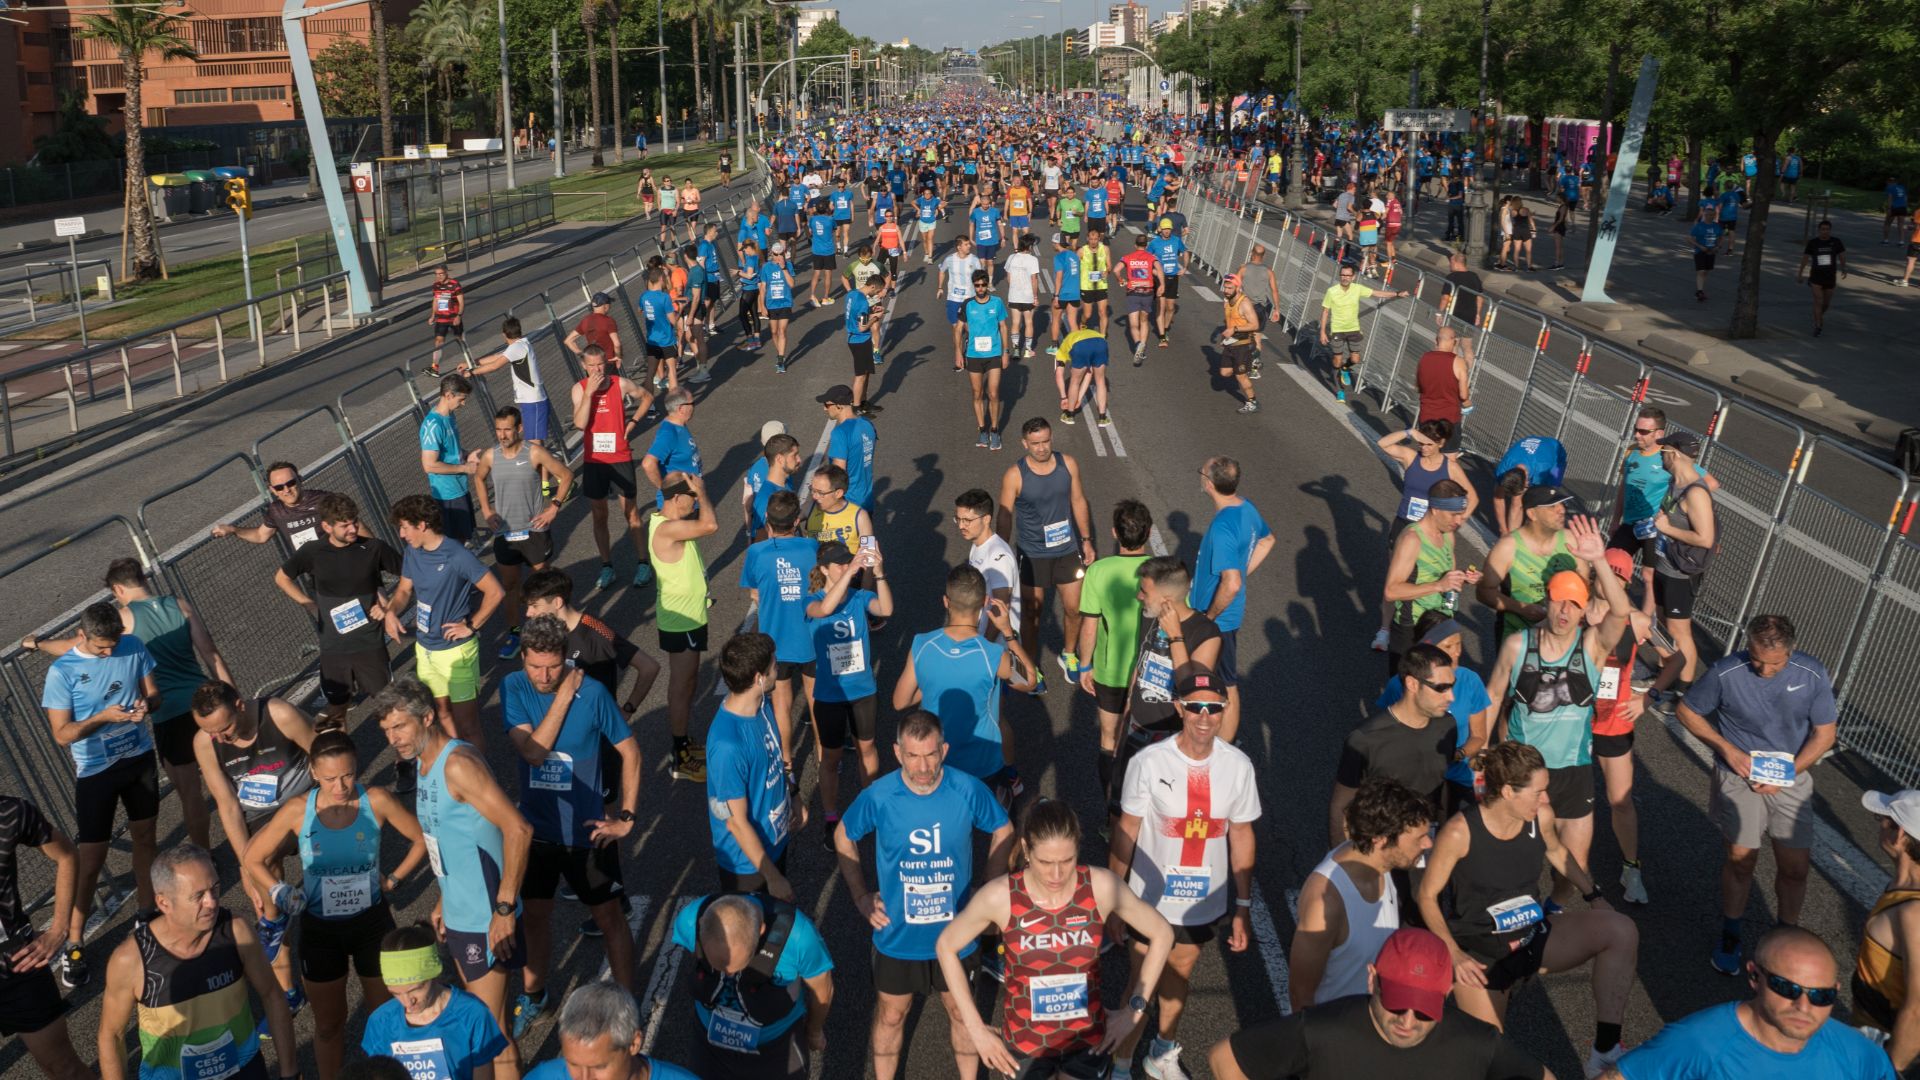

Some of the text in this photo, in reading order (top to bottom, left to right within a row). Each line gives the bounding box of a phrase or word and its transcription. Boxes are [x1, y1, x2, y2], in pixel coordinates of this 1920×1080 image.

[539, 765, 564, 773] ALEX
[899, 856, 954, 870] corre amb
[899, 870, 955, 884] bona vibra
[1170, 880, 1204, 890] JAUME
[329, 889, 364, 899] CINTIA
[335, 898, 360, 907] 2442
[910, 896, 947, 907] JAVIER
[917, 905, 942, 915] 2959
[1502, 909, 1538, 928] MARTA
[1019, 929, 1094, 950] KENYA
[1038, 991, 1081, 1005] FEDORA
[1045, 1002, 1075, 1013] 6075
[714, 1022, 752, 1043] RAMON
[194, 1052, 227, 1069] CESC
[198, 1062, 226, 1077] 6819
[410, 1070, 437, 1080] 490
